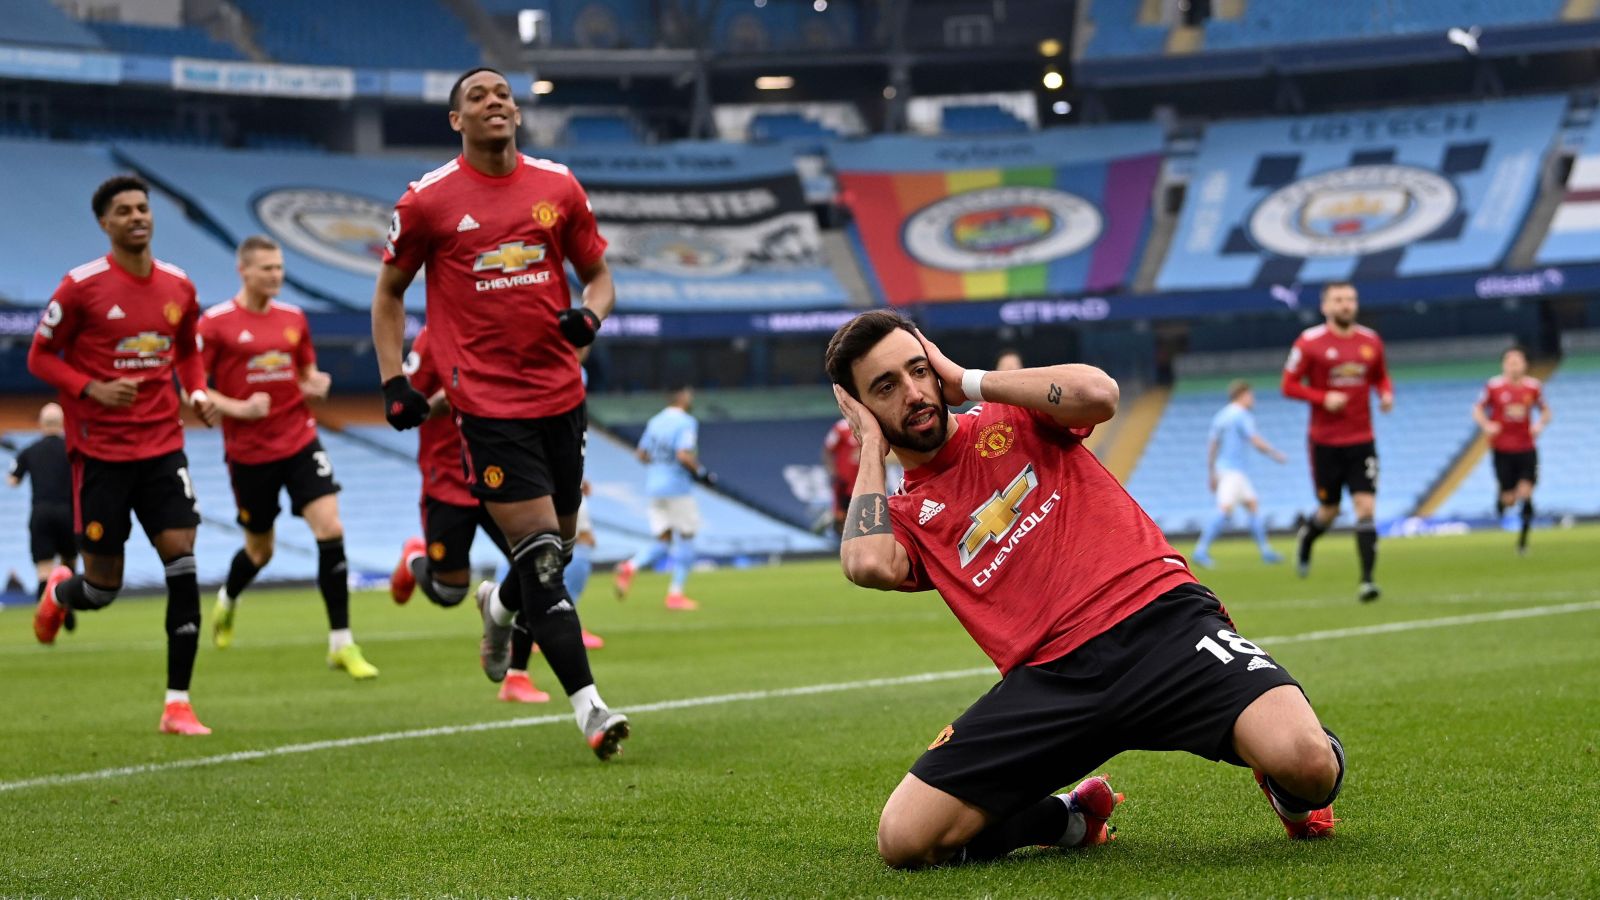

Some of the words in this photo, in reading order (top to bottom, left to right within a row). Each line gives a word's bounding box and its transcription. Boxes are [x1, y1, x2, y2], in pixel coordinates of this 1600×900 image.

[475, 271, 550, 291] CHEVROLET
[1000, 297, 1110, 325] ETIHAD
[918, 503, 946, 525] adidas
[971, 490, 1062, 588] CHEVROLET
[1195, 629, 1266, 665] 18
